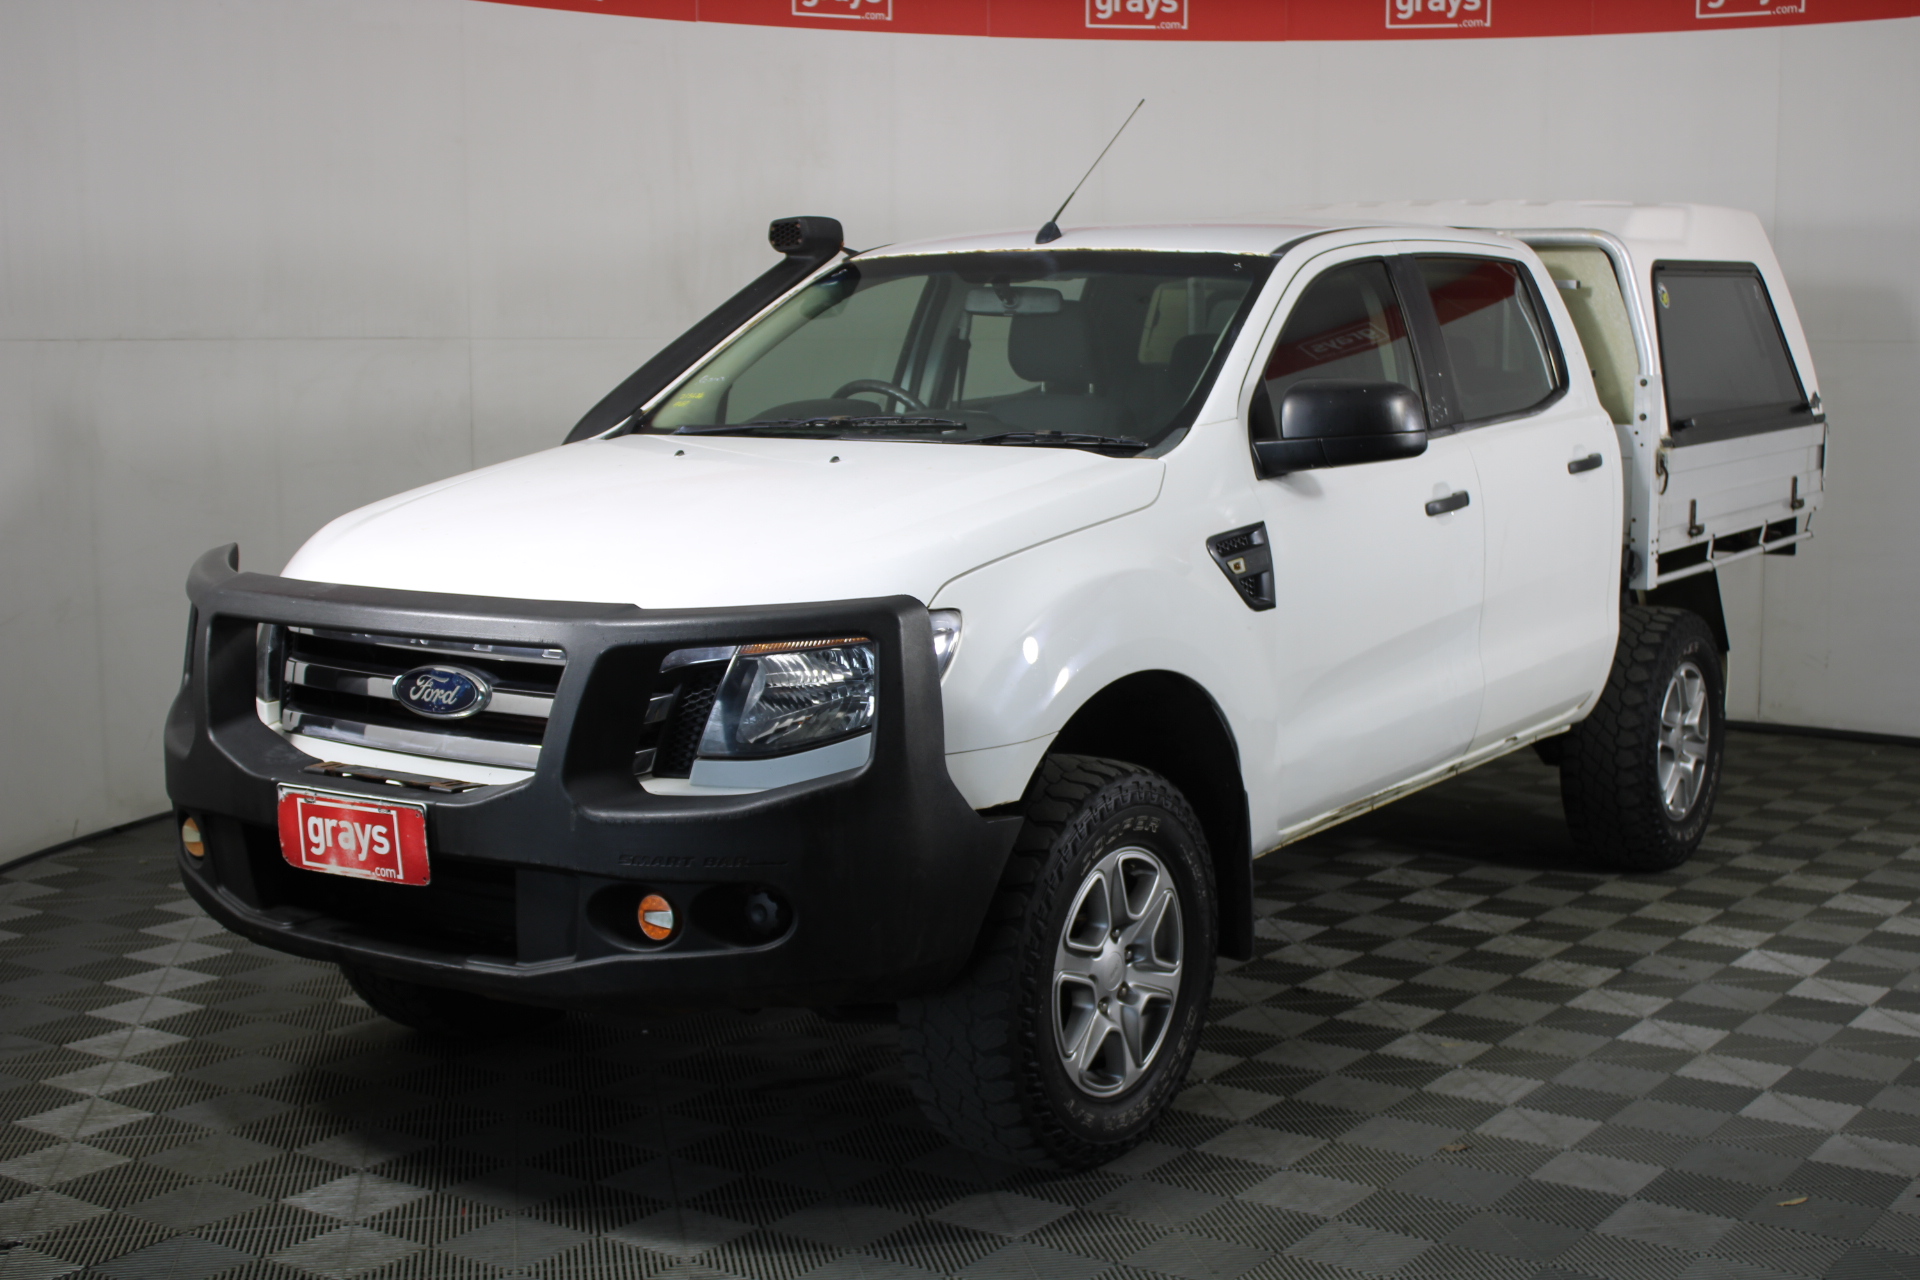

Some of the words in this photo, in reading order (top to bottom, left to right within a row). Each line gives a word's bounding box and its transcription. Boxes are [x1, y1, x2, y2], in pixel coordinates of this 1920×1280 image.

[409, 674, 461, 705] Ford
[307, 815, 391, 861] grays
[1080, 815, 1161, 877] COOPER
[371, 866, 397, 879] .com
[618, 854, 695, 868] SMART
[703, 856, 749, 868] BAR
